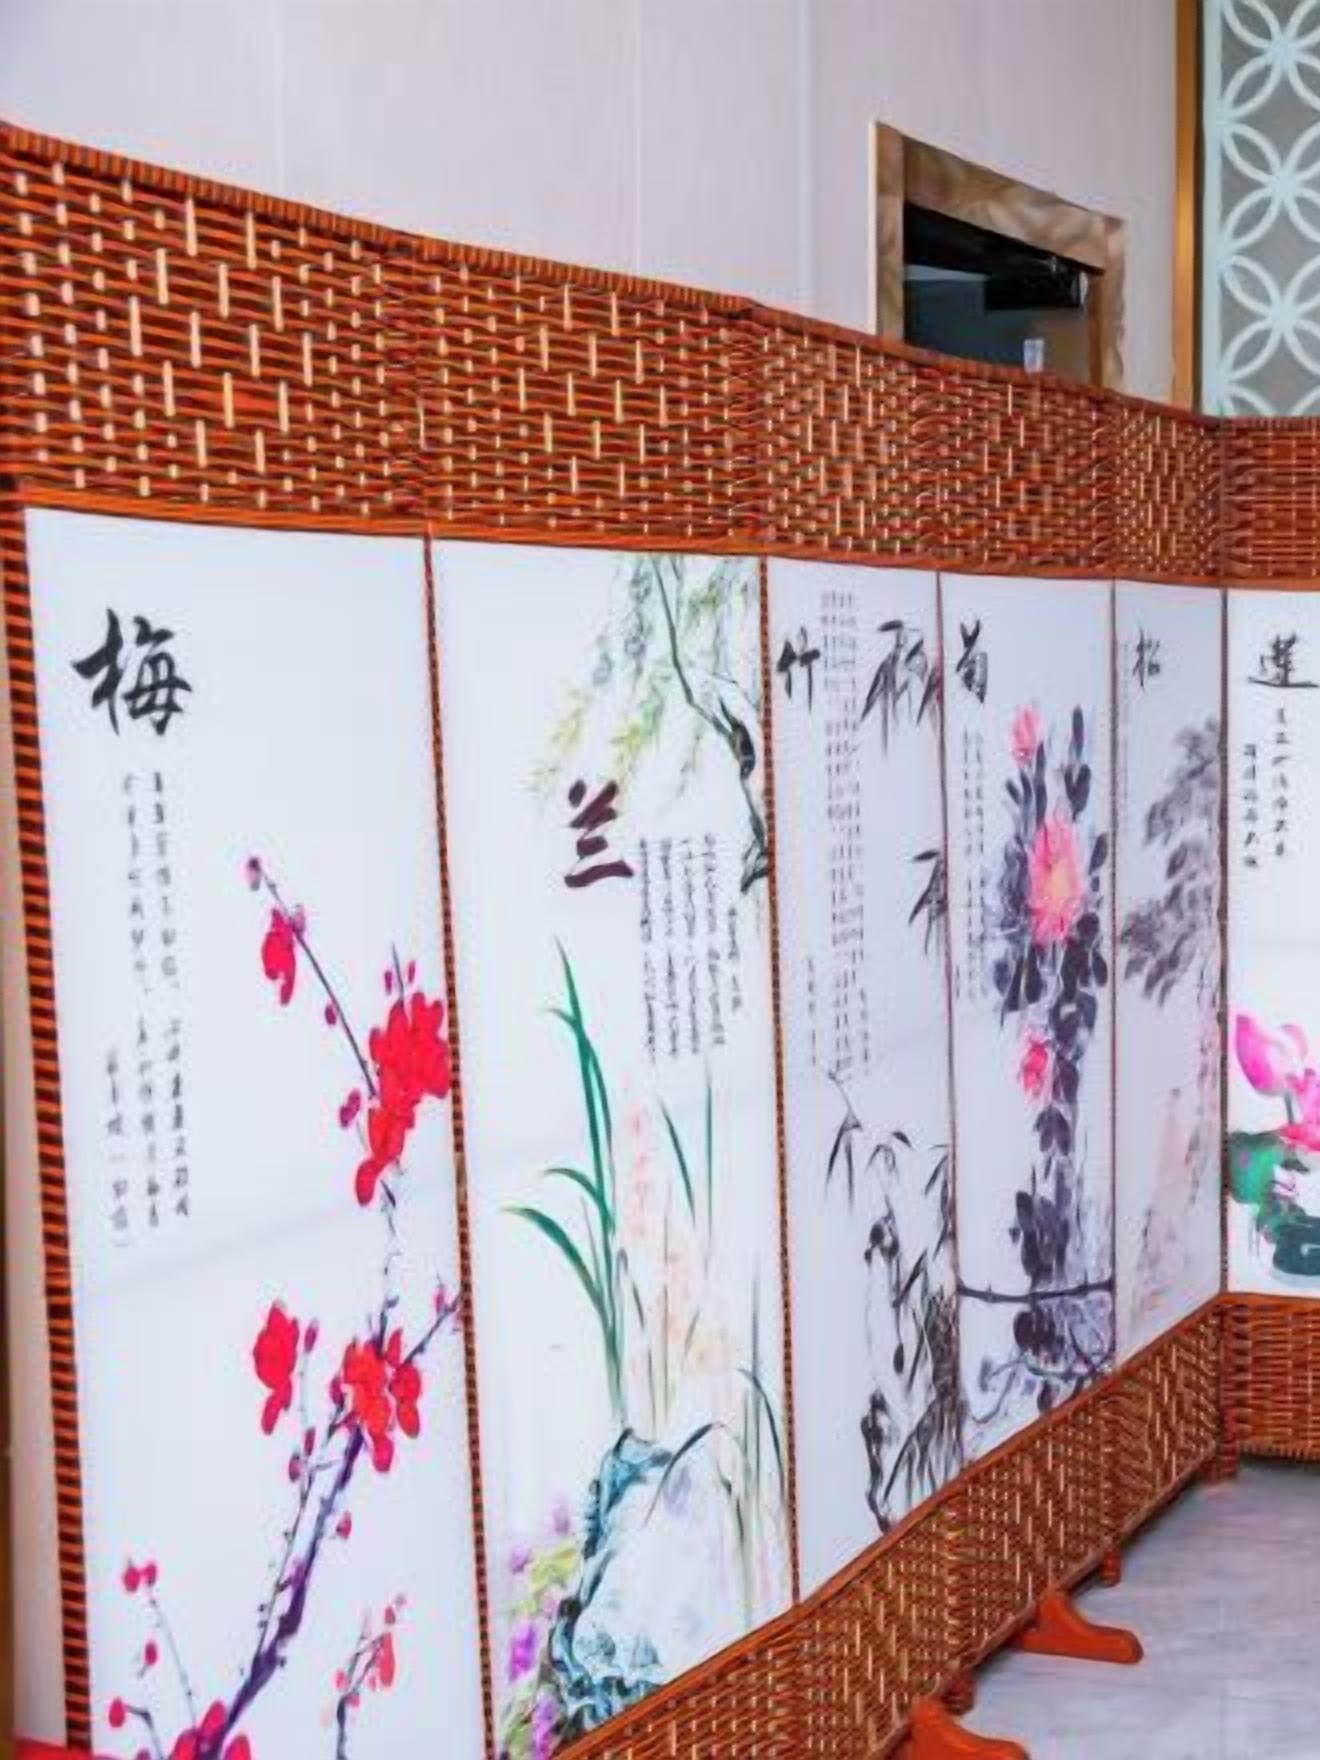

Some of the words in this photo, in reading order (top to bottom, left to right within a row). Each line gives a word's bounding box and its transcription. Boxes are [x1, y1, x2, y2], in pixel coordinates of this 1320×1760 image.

[71, 608, 193, 736] 梅
[777, 625, 821, 713] 竹
[564, 778, 635, 888] 兰
